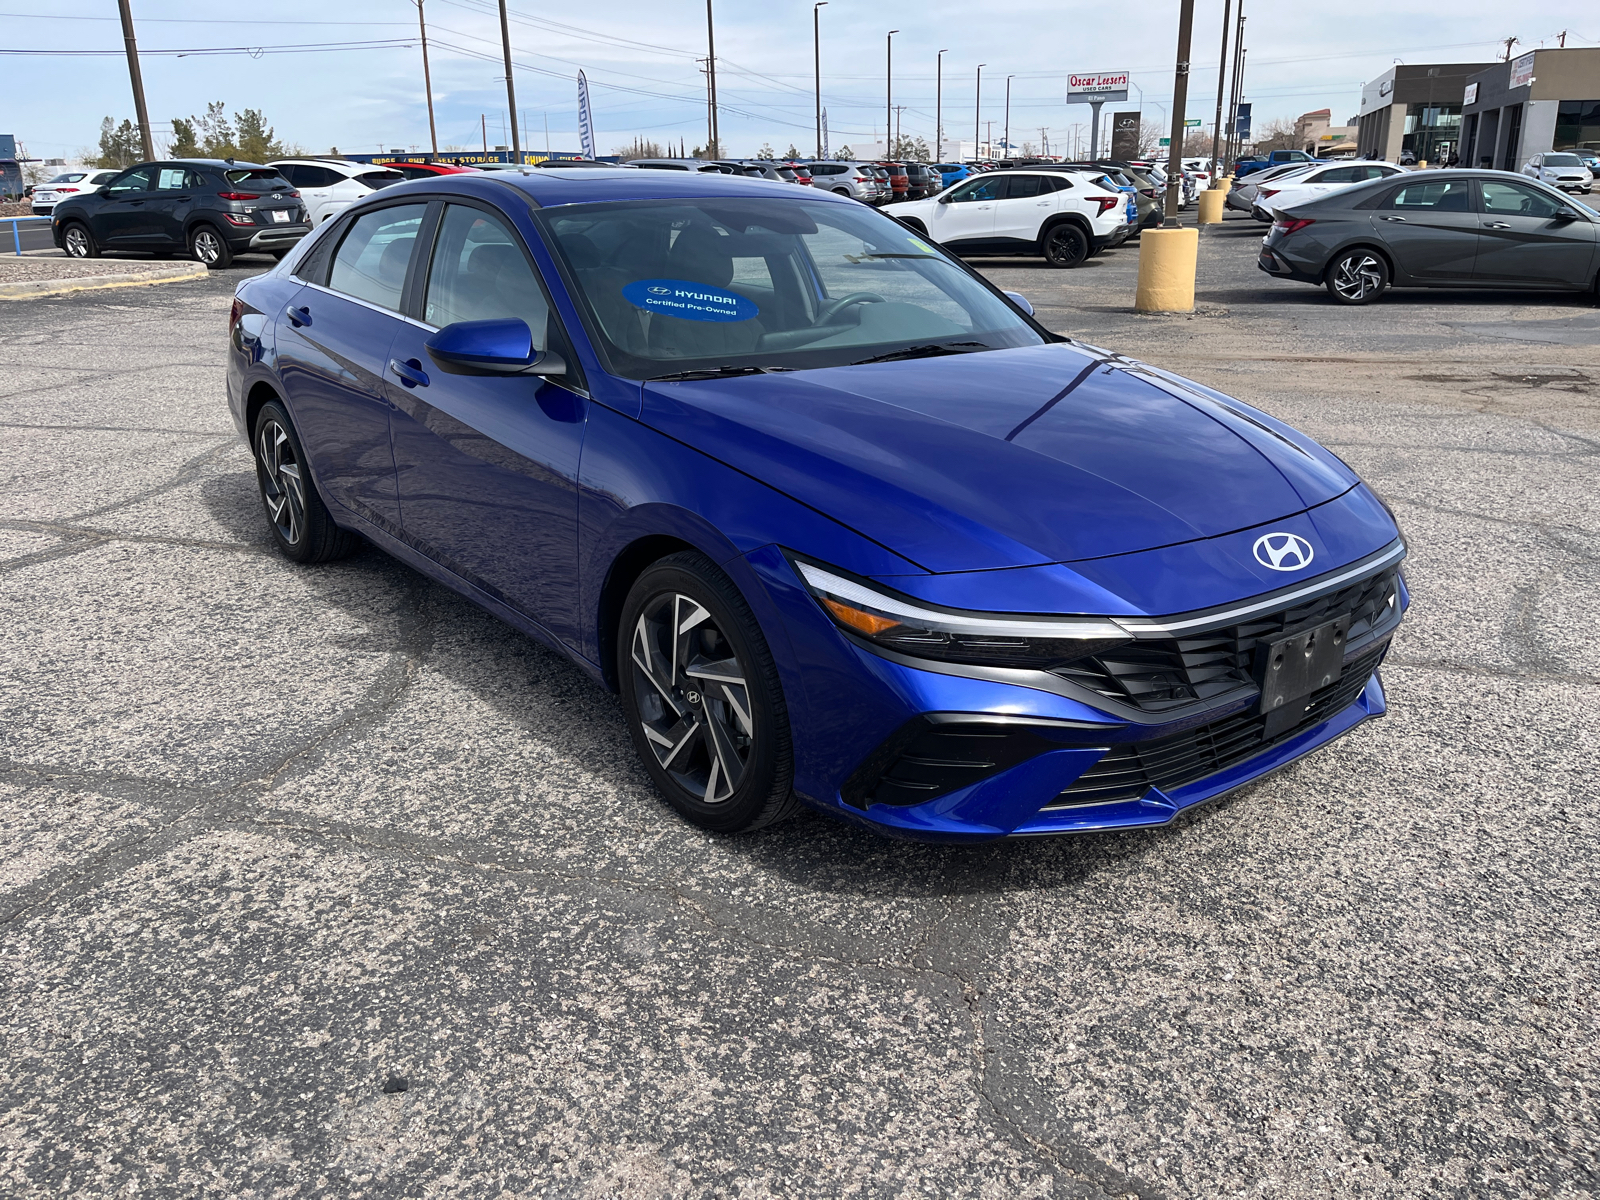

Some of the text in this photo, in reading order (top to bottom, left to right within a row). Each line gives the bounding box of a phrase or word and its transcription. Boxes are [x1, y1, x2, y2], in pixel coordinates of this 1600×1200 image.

[1070, 74, 1126, 86] Oscar Leeser's
[675, 290, 737, 305] HYUNDAI
[646, 298, 737, 316] Certified Pre-Owned
